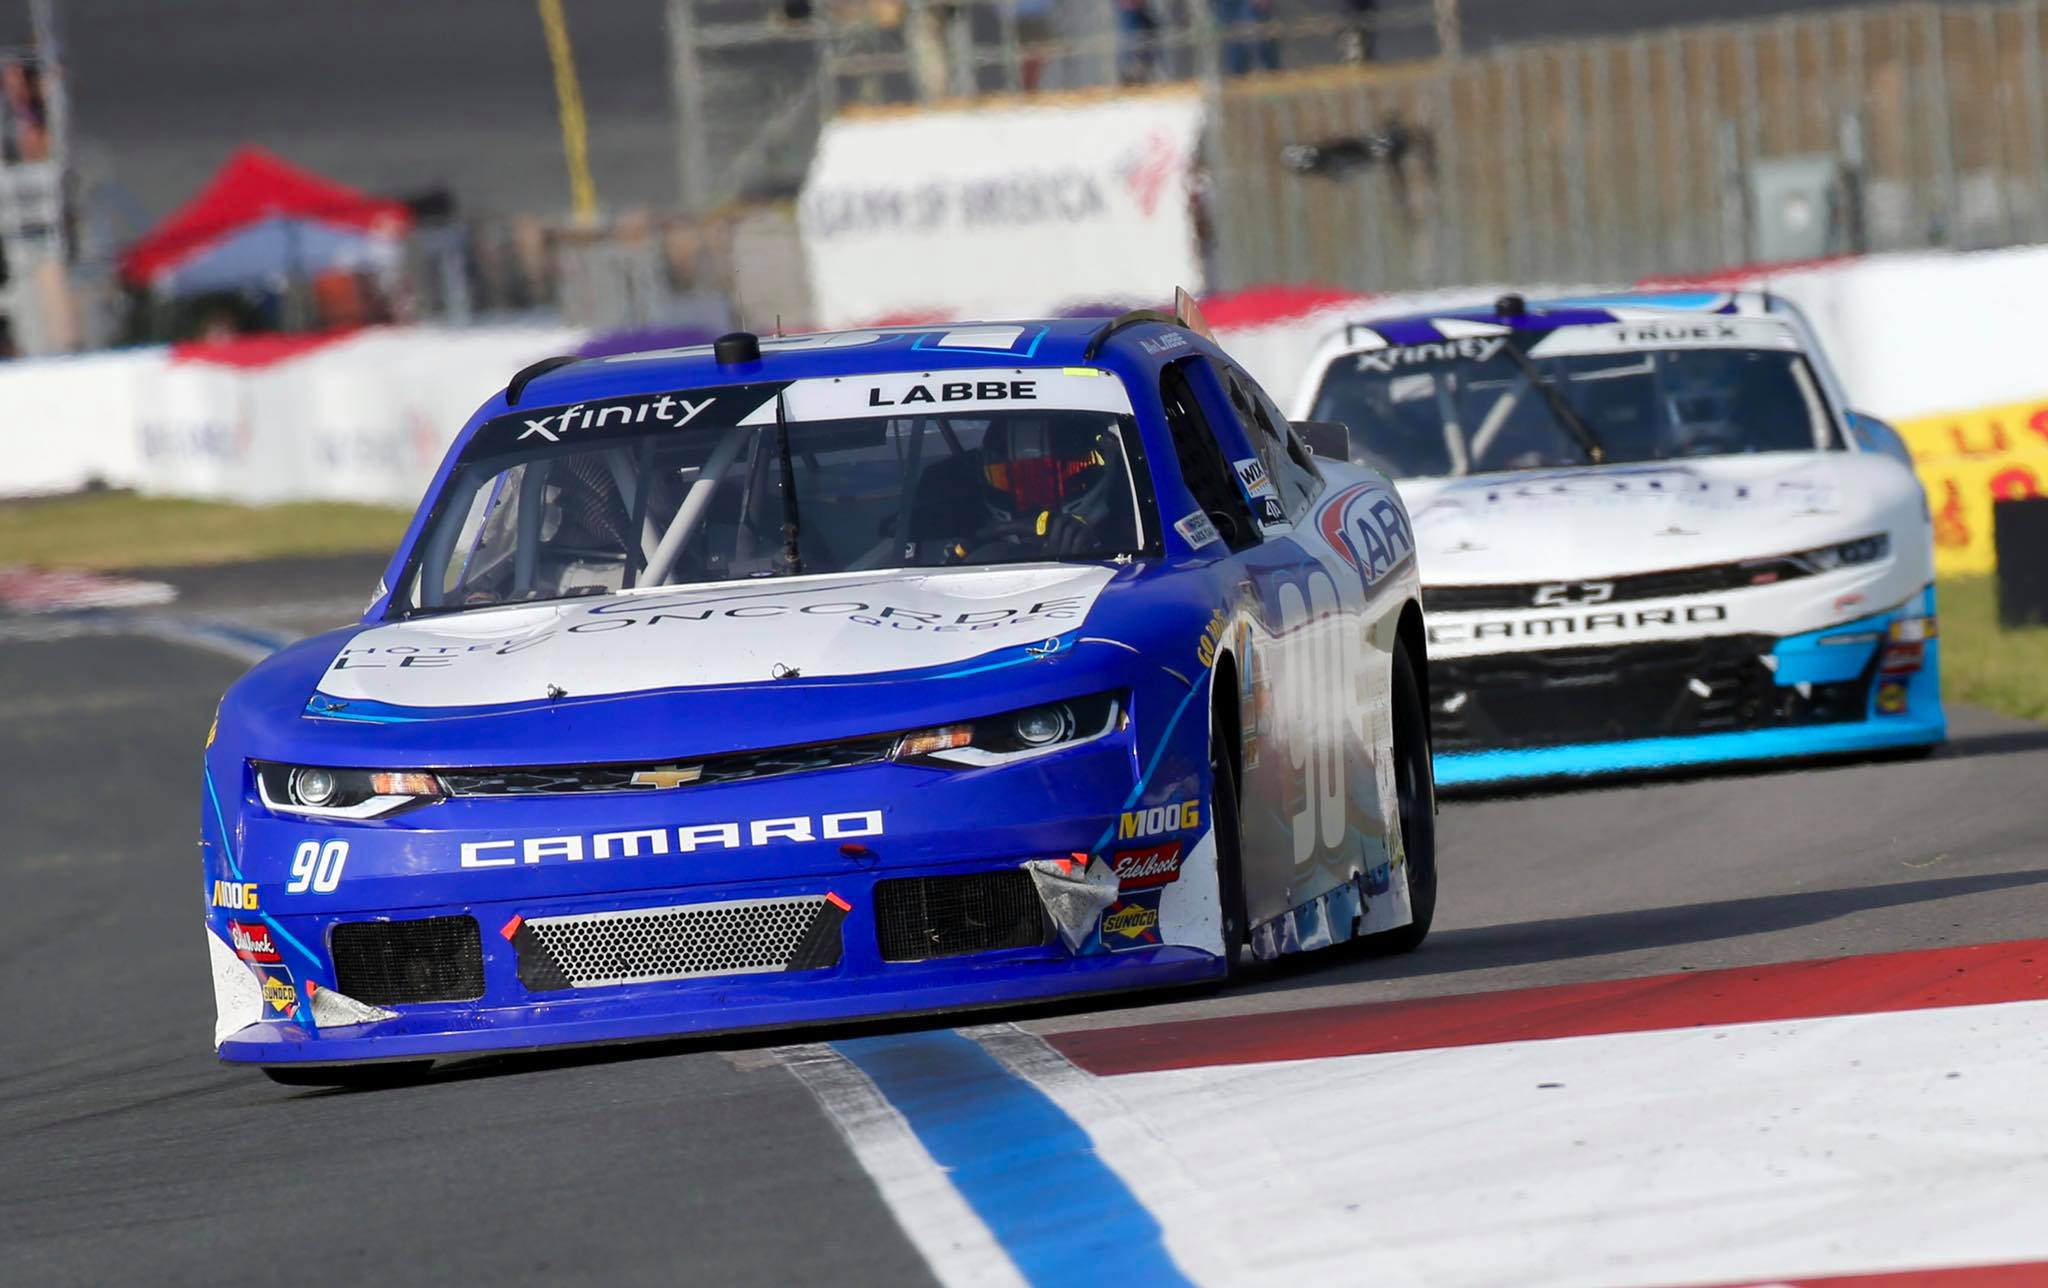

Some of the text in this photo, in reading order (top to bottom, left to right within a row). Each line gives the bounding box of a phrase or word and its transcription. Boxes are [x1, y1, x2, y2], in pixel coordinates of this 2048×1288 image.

[1615, 325, 1740, 341] TRUEX
[869, 380, 1037, 406] LABBE
[516, 394, 718, 442] xfinity
[1240, 460, 1266, 485] WIX
[1428, 604, 1727, 645] CAMARO
[333, 653, 460, 671] LE
[1118, 799, 1200, 840] MOOG
[460, 811, 885, 869] CAMARO
[285, 840, 349, 896] 90
[1113, 849, 1178, 879] Edelbrock
[1105, 911, 1155, 931] SUNOCO
[264, 986, 295, 1001] SUNOCO
